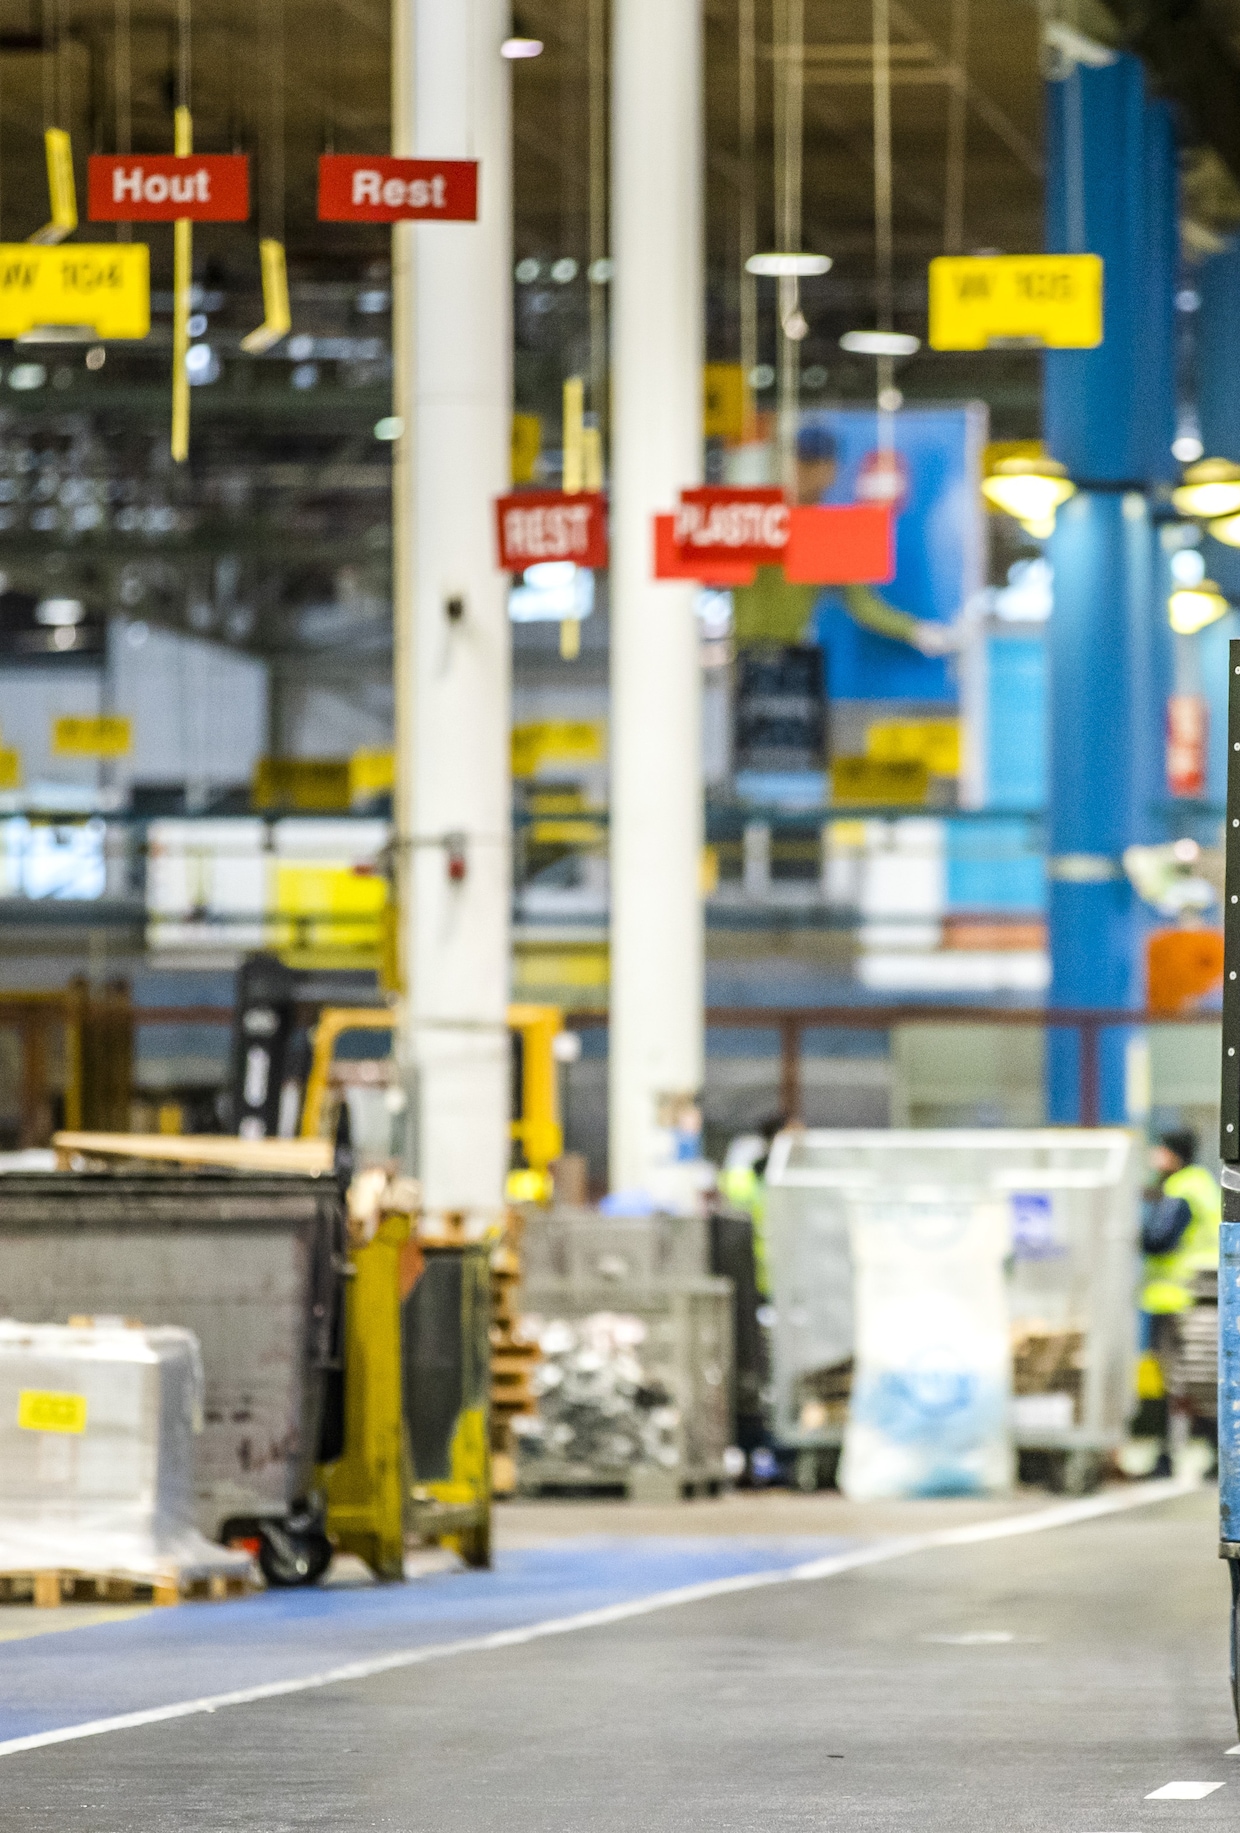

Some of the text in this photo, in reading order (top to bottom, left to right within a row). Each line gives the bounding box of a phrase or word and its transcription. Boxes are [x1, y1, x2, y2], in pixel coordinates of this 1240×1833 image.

[112, 167, 211, 203] Hout
[352, 170, 447, 208] Rest
[504, 505, 590, 557] REST
[673, 504, 791, 548] PLASTIC
